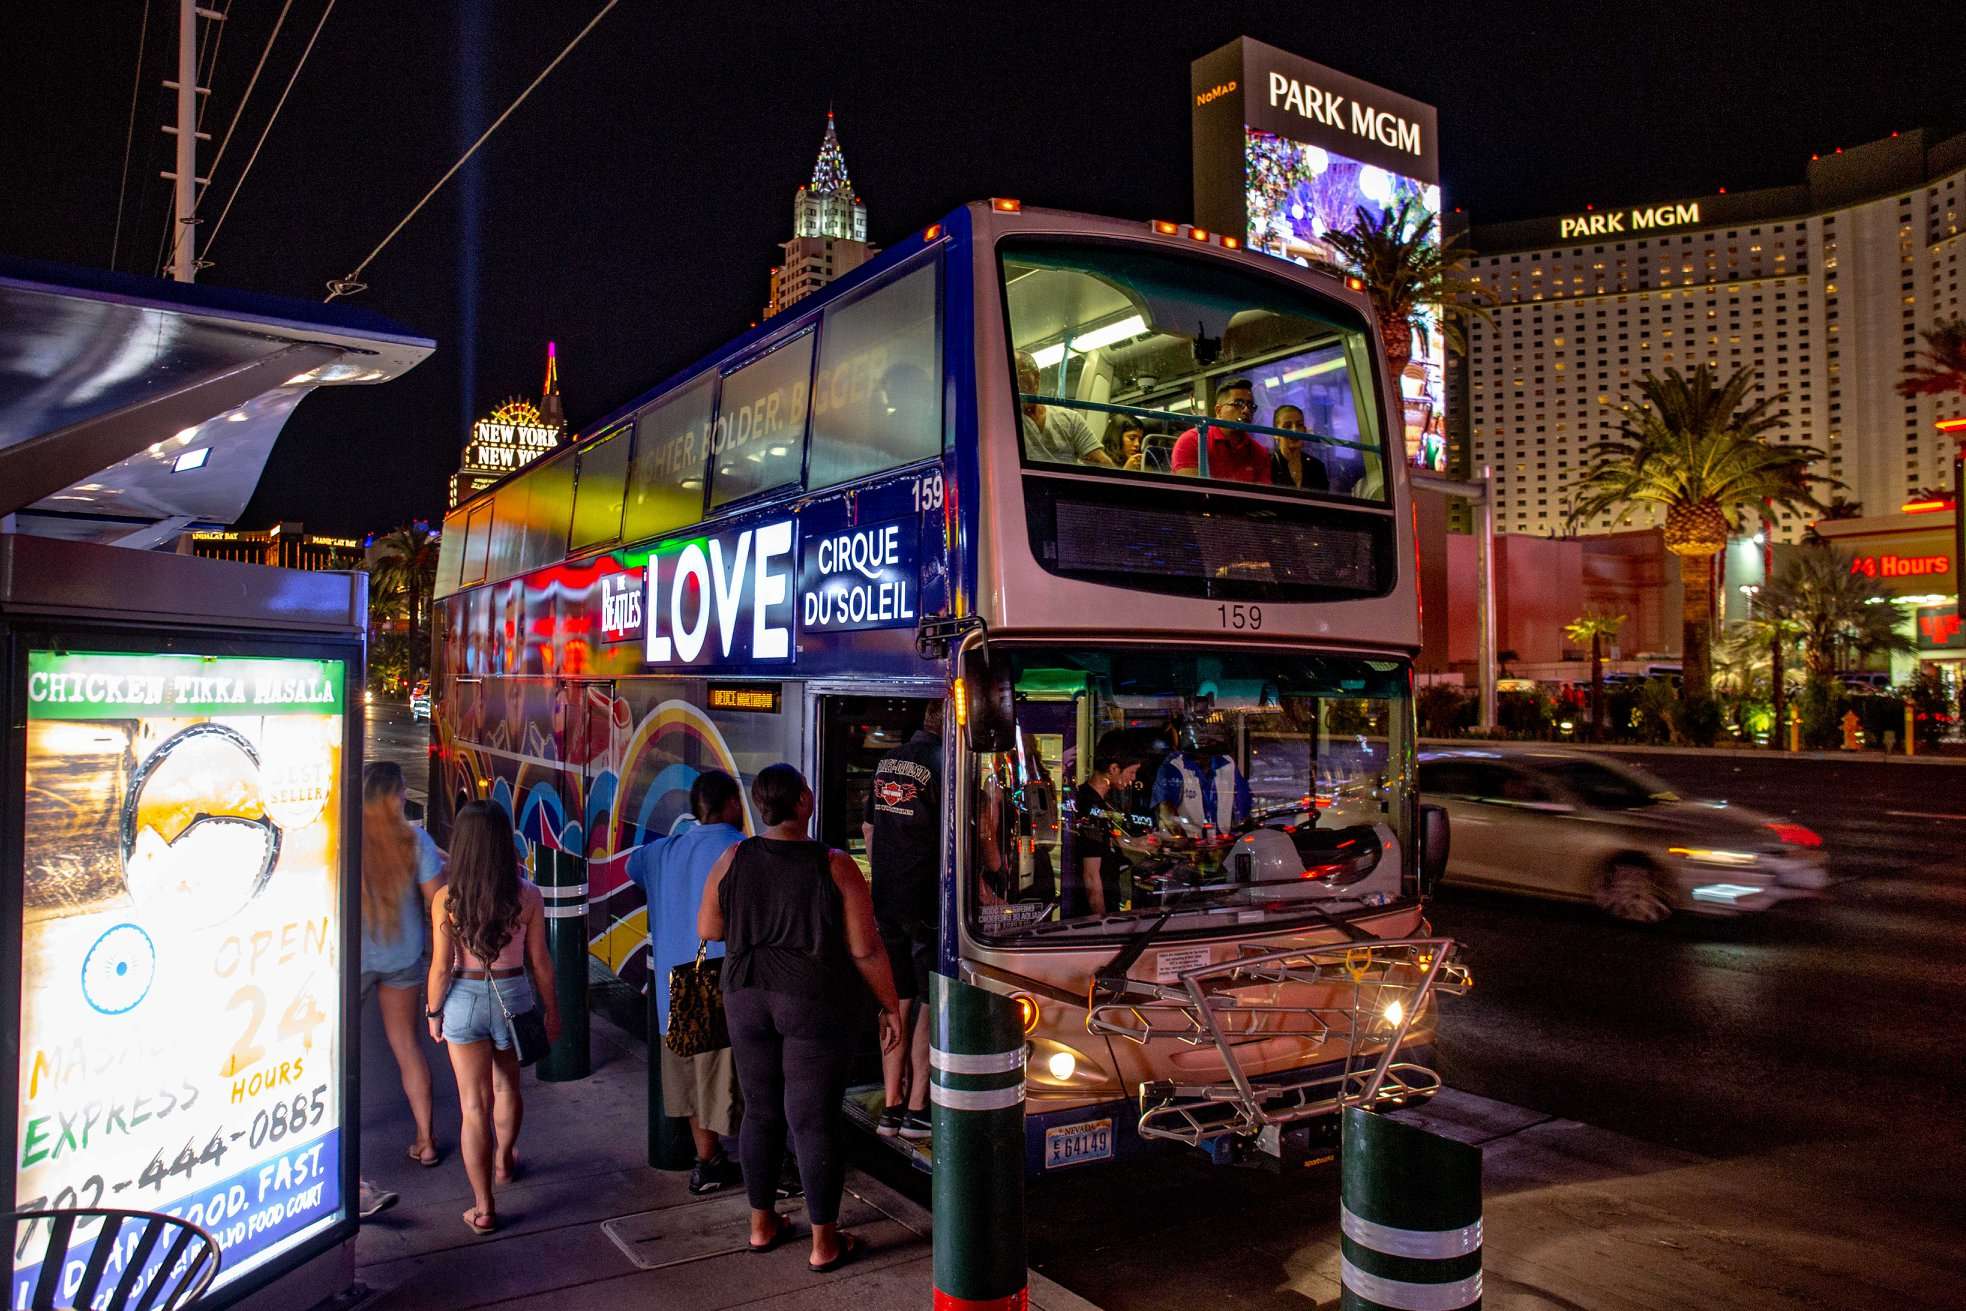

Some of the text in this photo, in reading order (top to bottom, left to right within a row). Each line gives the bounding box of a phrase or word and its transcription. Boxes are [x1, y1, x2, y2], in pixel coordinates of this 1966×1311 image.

[1269, 72, 1421, 156] PARK MGM
[1560, 203, 1699, 239] PARK MGM
[478, 446, 545, 467] NEW YO
[479, 423, 559, 447] NEW YORK
[912, 475, 943, 512] 159
[818, 525, 899, 579] CIRQUE
[1880, 555, 1949, 577] Hours
[617, 575, 626, 591] THE
[646, 520, 792, 663] LOVE
[804, 581, 914, 626] DU SOLEIL
[601, 578, 642, 636] BEATLES
[1217, 604, 1262, 630] 159
[29, 672, 335, 705] CHICKEN TIKKA MASALA
[271, 786, 322, 804] SELLER
[213, 916, 329, 979] OPEN
[218, 983, 327, 1079] 24
[231, 1056, 304, 1105] HOURS
[22, 1083, 200, 1169] EXPRESS
[1064, 1132, 1107, 1158] 64149
[258, 1142, 325, 1203] FAST.
[248, 1203, 285, 1241] FOOD
[286, 1181, 325, 1219] COURT
